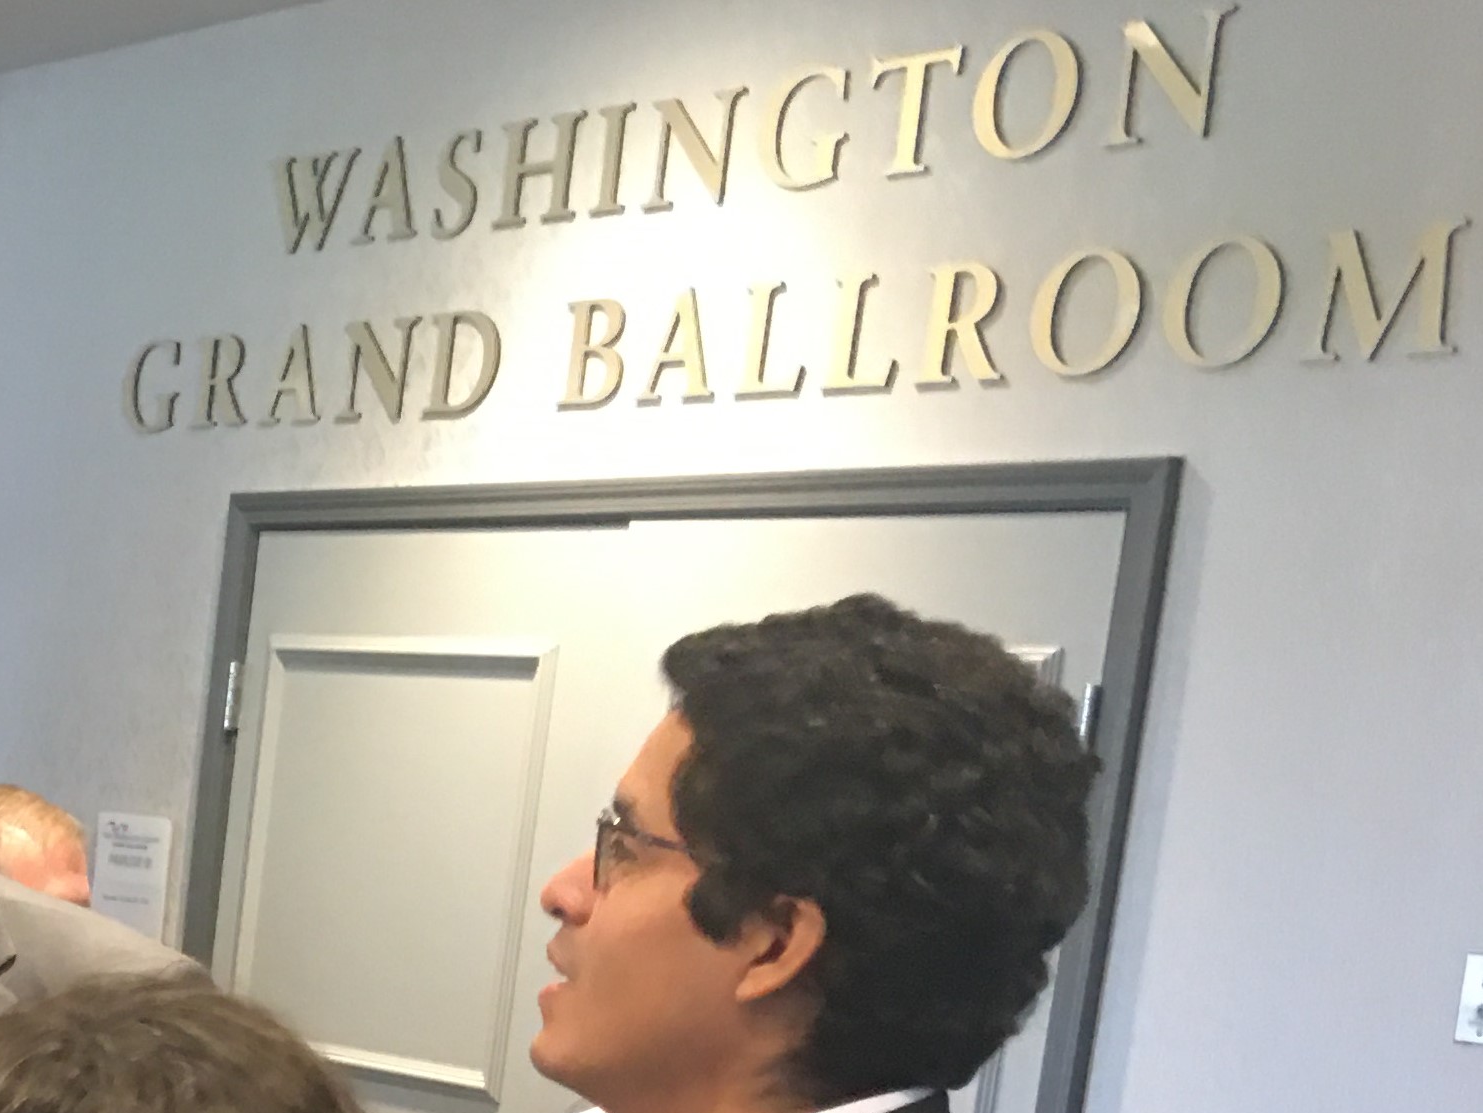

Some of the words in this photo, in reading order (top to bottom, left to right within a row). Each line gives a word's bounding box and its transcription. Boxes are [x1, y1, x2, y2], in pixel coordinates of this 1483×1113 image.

[275, 4, 1240, 254] WASHINGTON
[122, 308, 504, 435] GRAND
[554, 214, 1473, 413] BALLROOM
